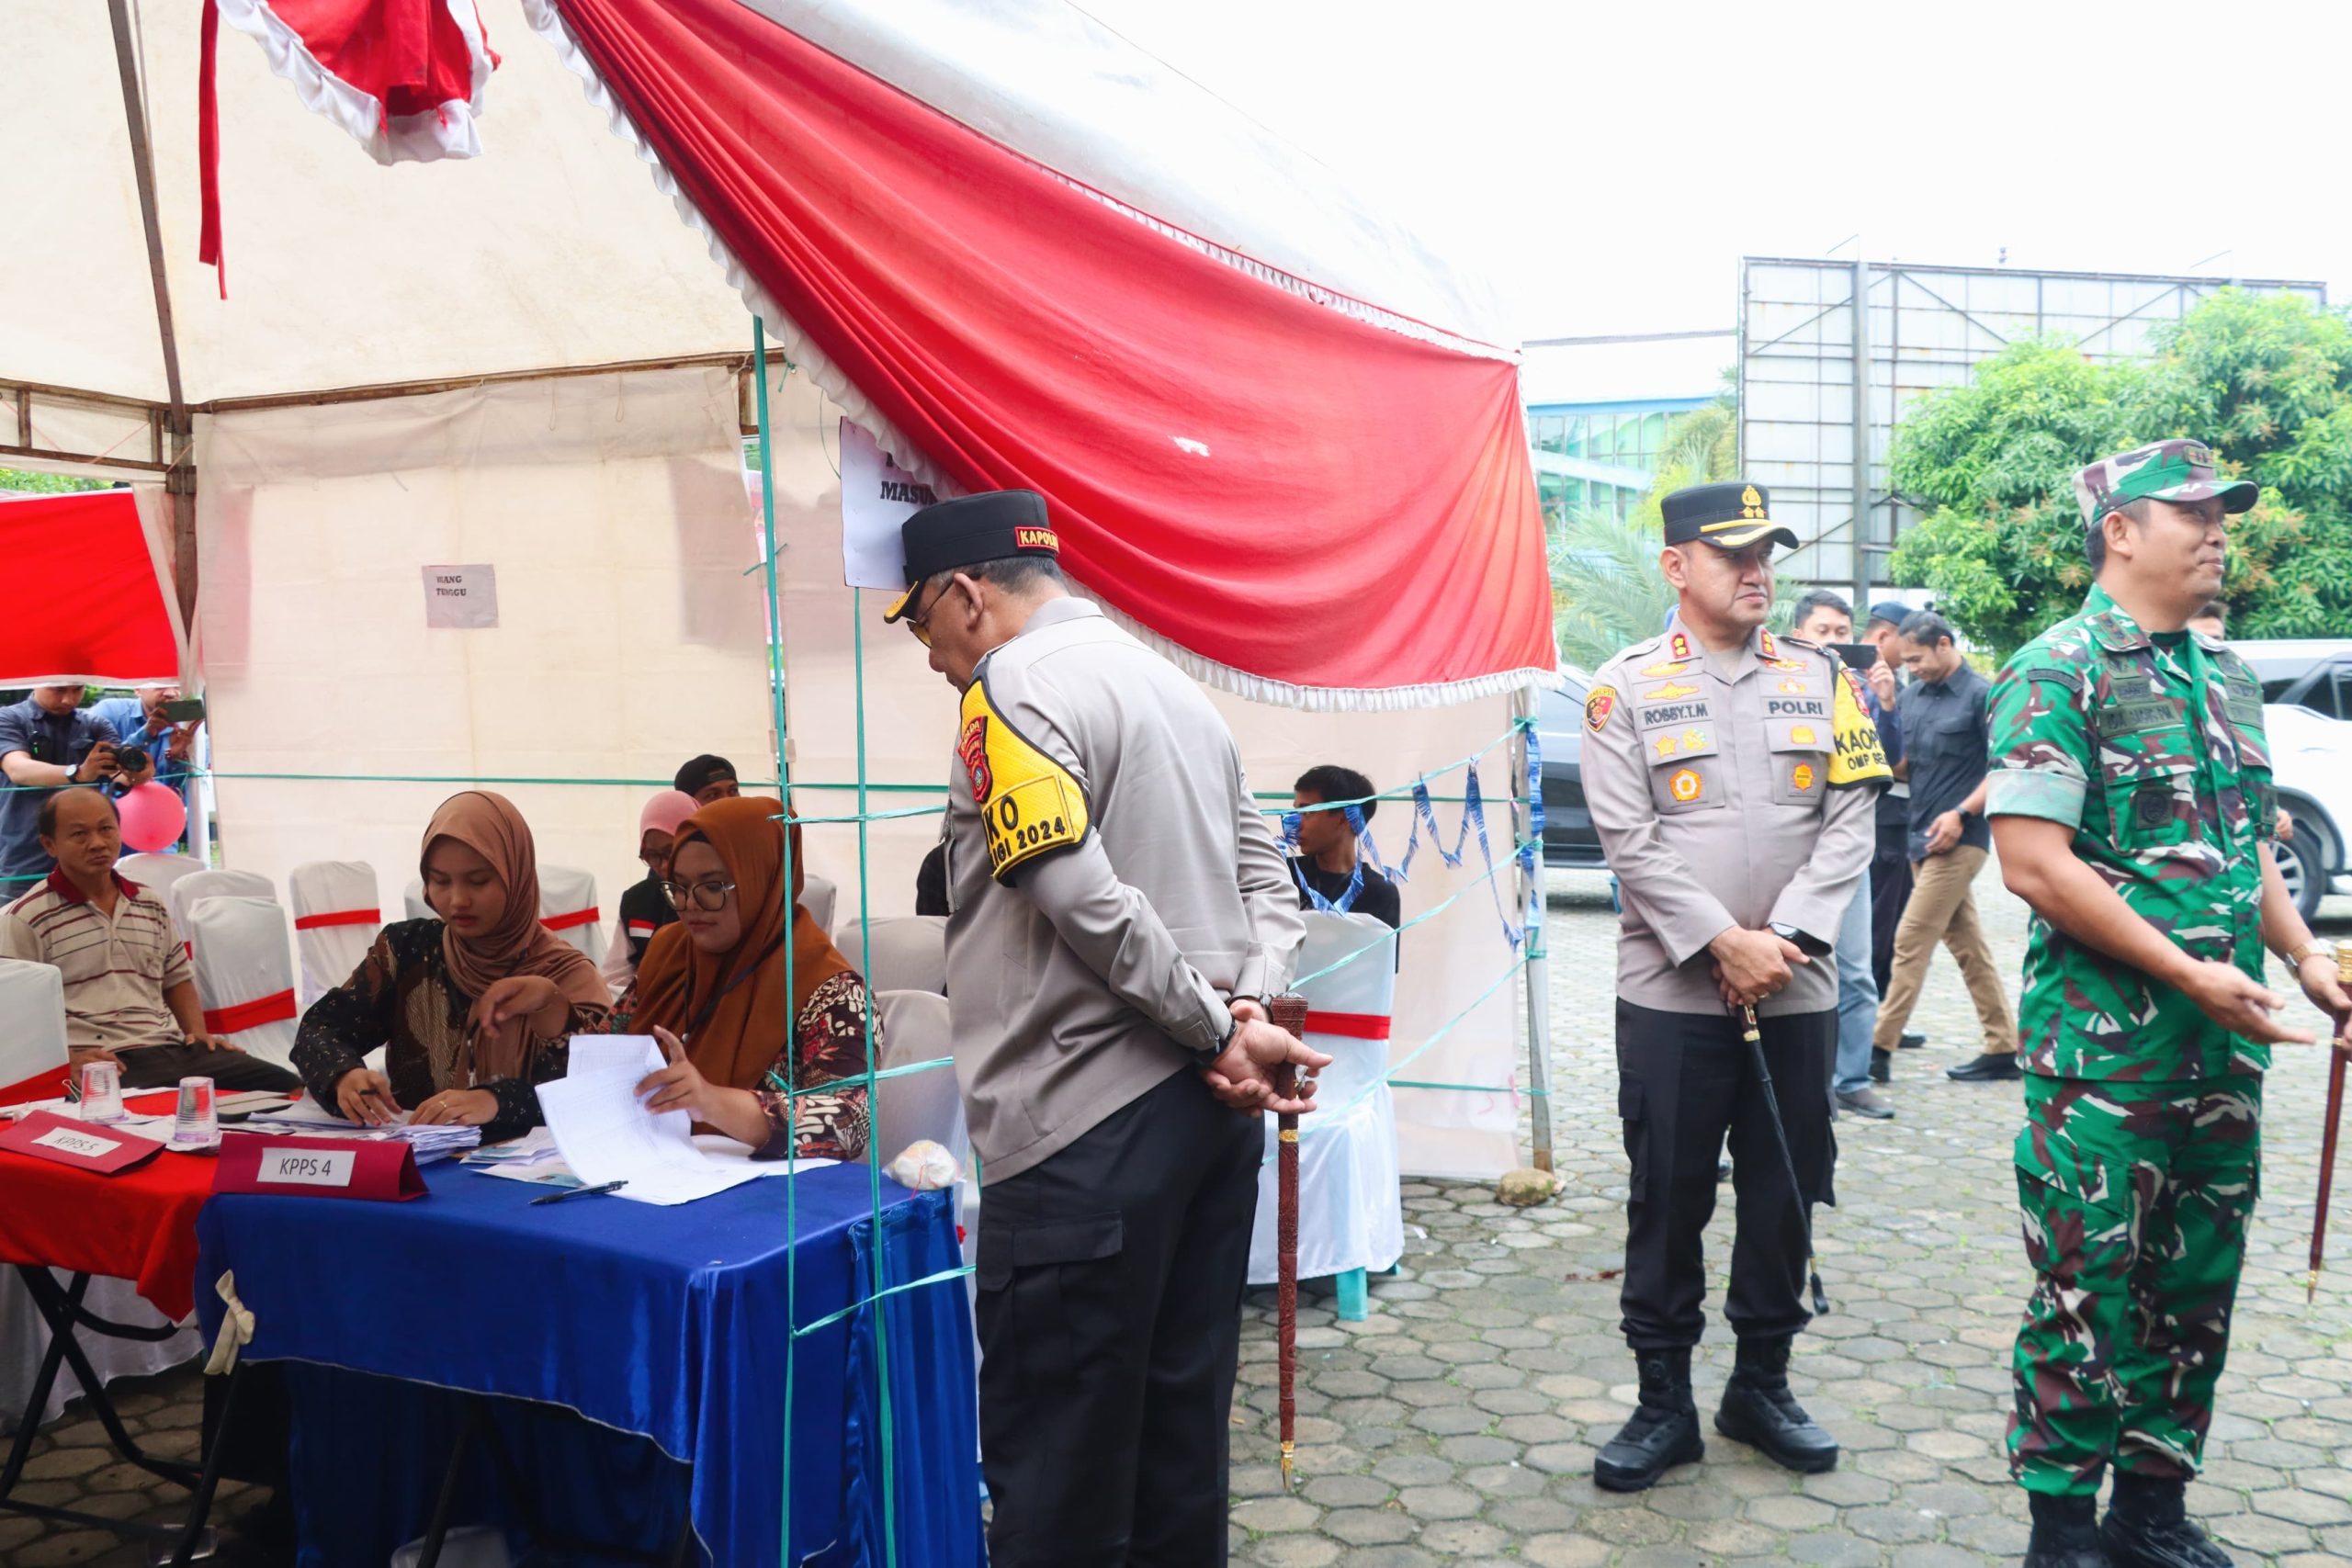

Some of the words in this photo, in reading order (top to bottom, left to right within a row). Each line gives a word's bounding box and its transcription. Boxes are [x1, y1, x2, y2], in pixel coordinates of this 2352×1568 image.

[1769, 701, 1823, 716] POLRI
[1016, 816, 1067, 850] 2024
[54, 1135, 90, 1150] KPPS
[83, 1143, 100, 1152] 5
[279, 1157, 319, 1177] KPPS
[321, 1159, 332, 1177] 4
